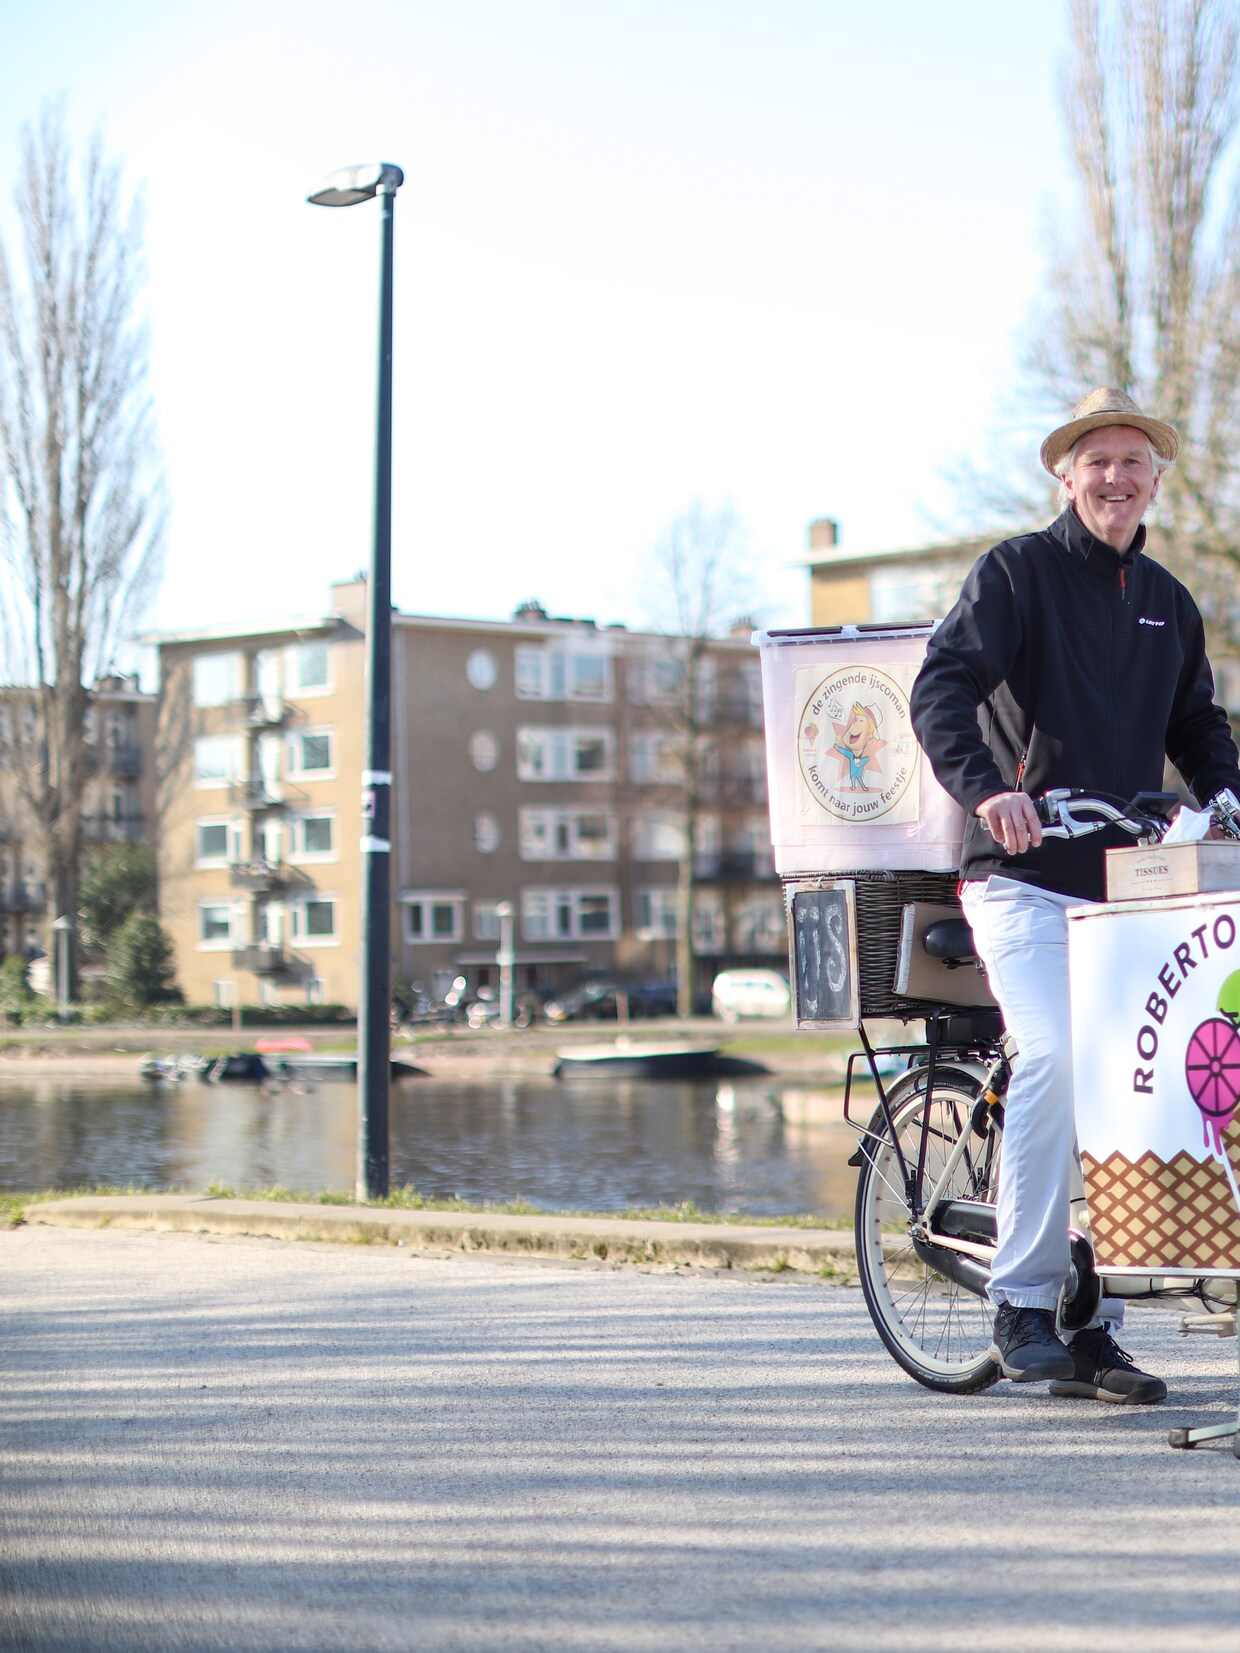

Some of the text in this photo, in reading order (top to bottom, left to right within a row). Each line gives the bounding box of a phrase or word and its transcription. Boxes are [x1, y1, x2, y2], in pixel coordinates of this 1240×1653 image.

[812, 672, 906, 719] de zingende ijscoman
[808, 765, 907, 816] komt naar jouw feestje
[1134, 865, 1169, 877] TISSUES
